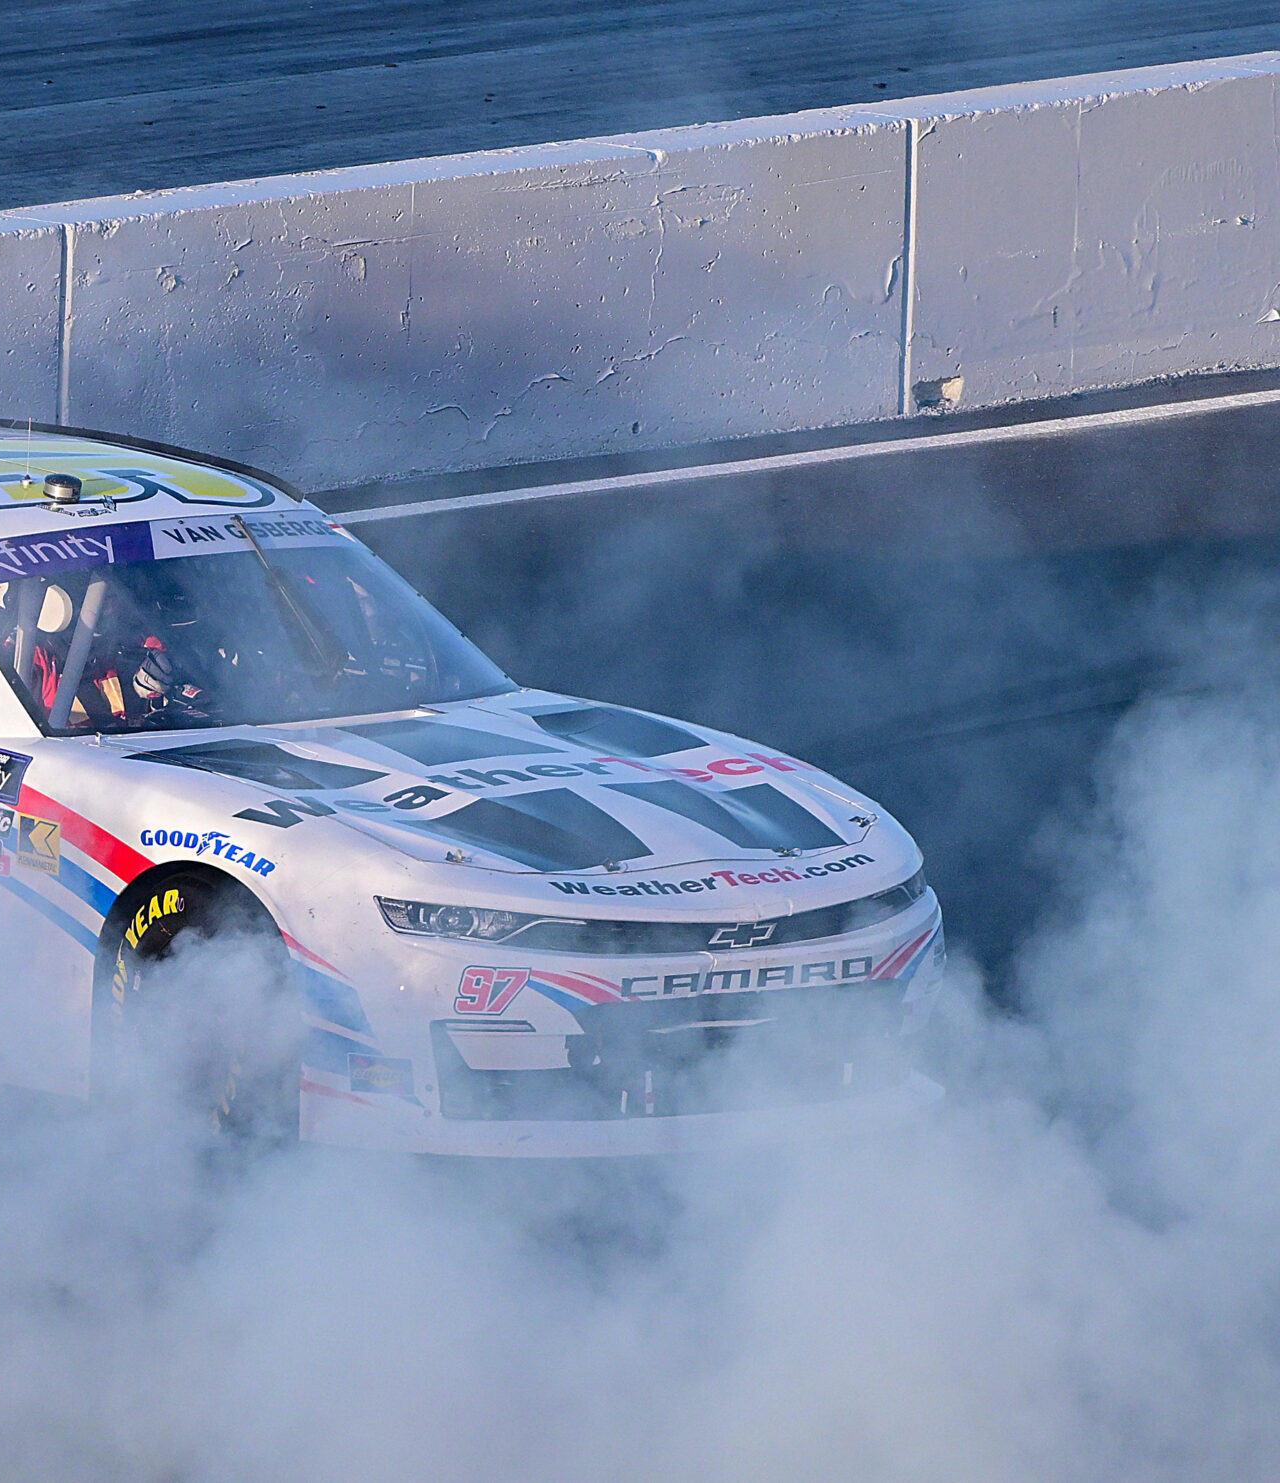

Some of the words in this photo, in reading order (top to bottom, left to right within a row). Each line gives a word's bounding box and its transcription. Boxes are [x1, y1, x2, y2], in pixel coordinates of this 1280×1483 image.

[162, 526, 225, 544] VAN
[224, 519, 336, 539] GSBERGE
[232, 752, 816, 830] WeatherTech
[125, 889, 179, 949] YEAR
[453, 964, 532, 1016] 97
[621, 955, 873, 997] CAMARO
